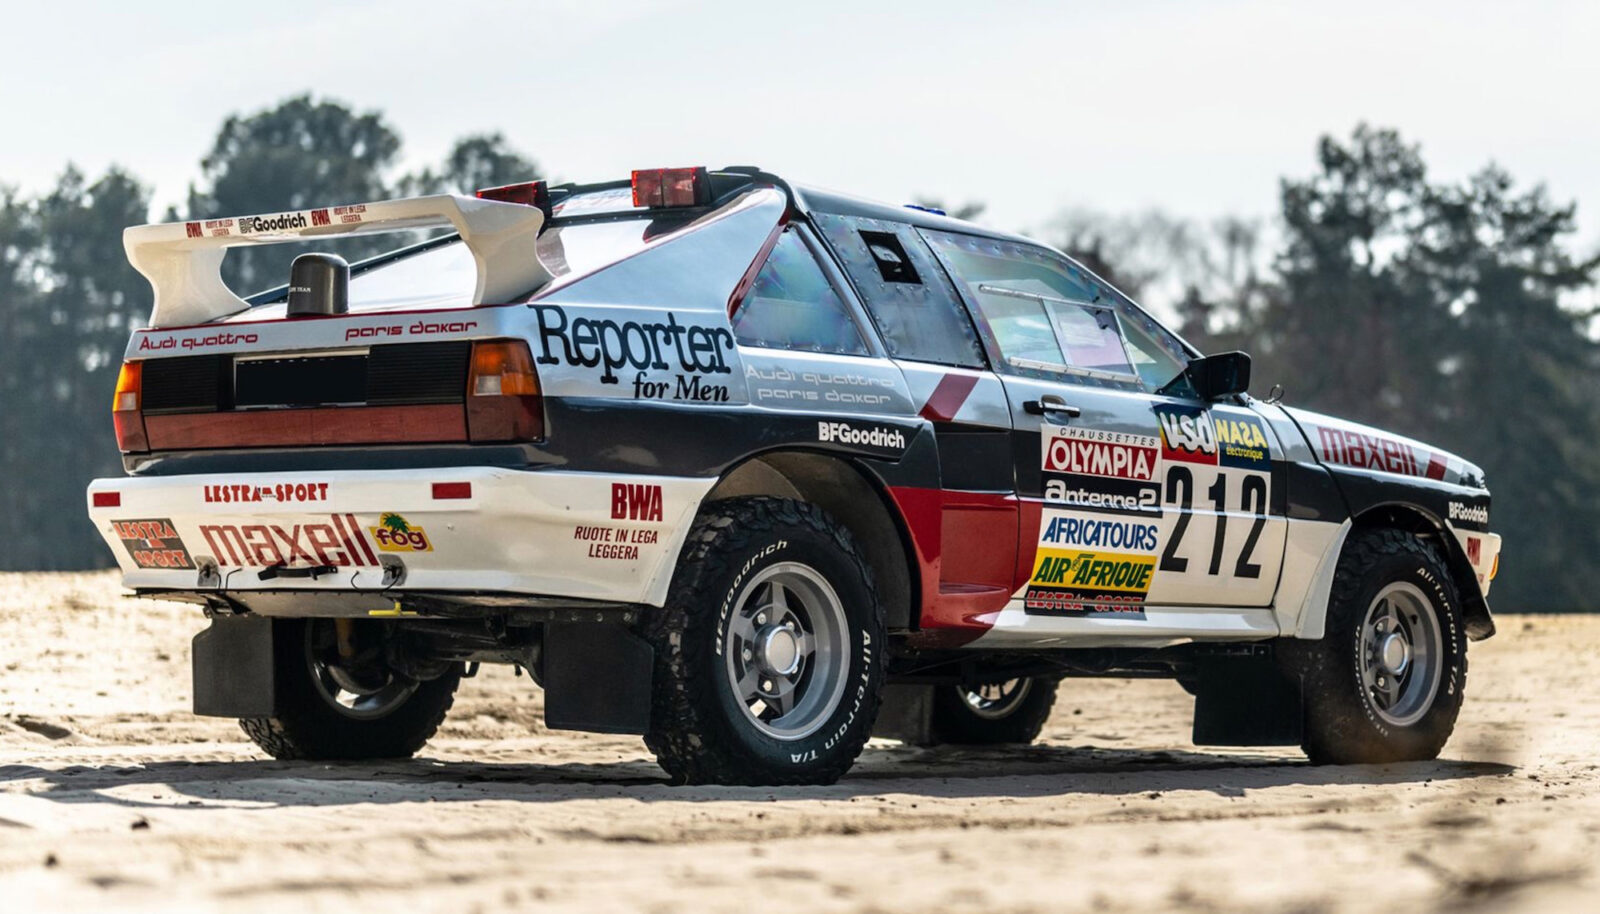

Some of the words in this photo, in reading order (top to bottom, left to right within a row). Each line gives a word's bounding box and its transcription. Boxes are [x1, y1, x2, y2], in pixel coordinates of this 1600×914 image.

[239, 212, 307, 234] BFGoodrich
[311, 209, 331, 226] BWA
[139, 336, 177, 351] Audi
[181, 333, 258, 349] quattro
[345, 325, 403, 341] paris
[409, 321, 478, 335] dakar
[528, 303, 733, 384] Reporter
[632, 371, 670, 400] for
[674, 374, 730, 402] Men
[746, 364, 796, 381] Audi
[802, 372, 896, 387] quattro
[757, 388, 819, 400] paris
[825, 389, 891, 404] dakar
[818, 421, 905, 449] BFGoodrich
[1060, 427, 1156, 447] CHAUSSETTES
[1051, 439, 1151, 480] OLYMPIA
[1317, 426, 1418, 477] maxell
[204, 484, 262, 502] LESTRA
[275, 483, 329, 502] SPORT
[611, 483, 663, 522] BWA
[1159, 465, 1267, 579] 212
[1448, 501, 1488, 524] BFGoodrich
[113, 521, 179, 540] LESTRA
[199, 513, 380, 566] maxell
[376, 528, 428, 551] fog
[574, 526, 612, 542] RUOTE
[615, 529, 628, 543] IN
[631, 529, 658, 544] LEGA
[1042, 517, 1158, 550] AFRICATOURS
[134, 550, 189, 567] SPORT
[588, 543, 638, 560] LEGGERA
[1033, 556, 1071, 584] AIR
[1072, 560, 1154, 588] AFRIQUE
[716, 539, 787, 656] BFGoodrich
[824, 629, 872, 750] All-Terrain
[791, 752, 818, 764] T/A
